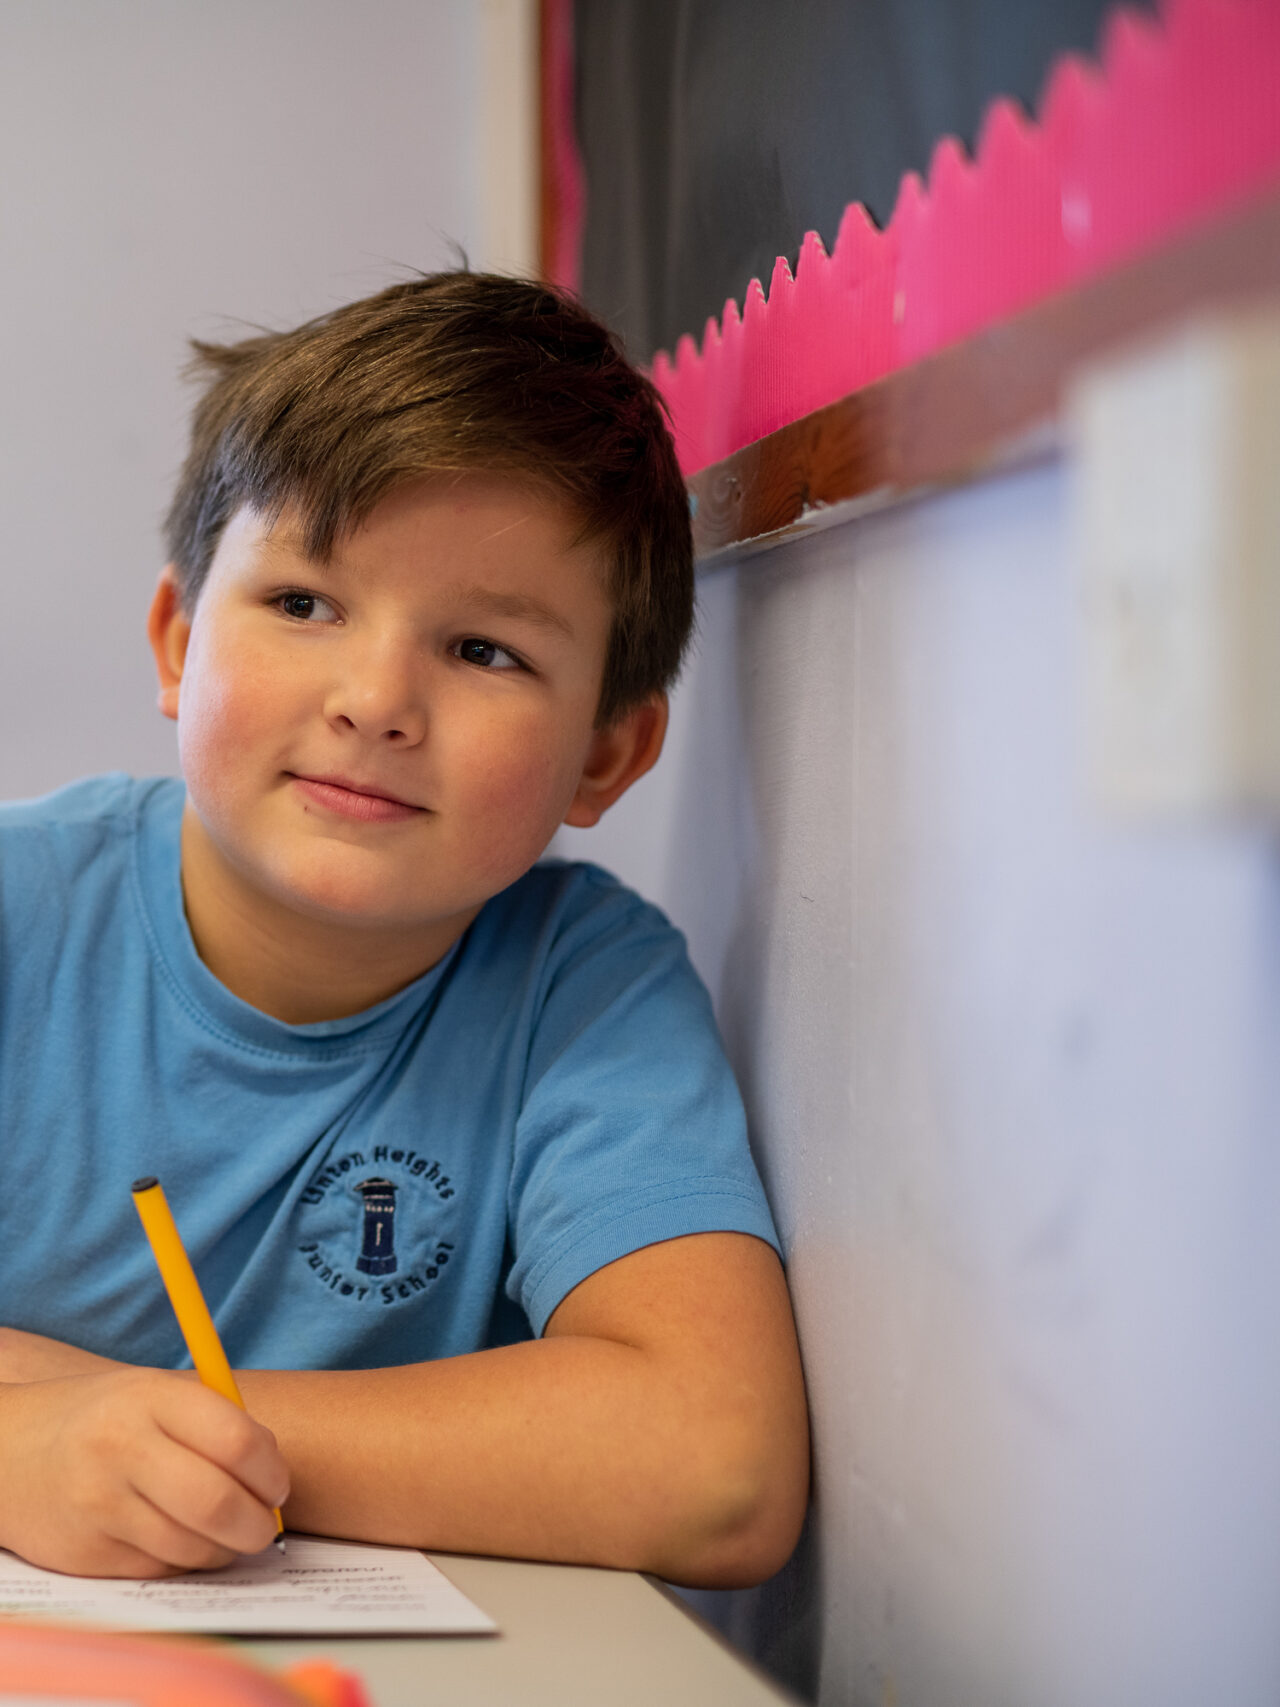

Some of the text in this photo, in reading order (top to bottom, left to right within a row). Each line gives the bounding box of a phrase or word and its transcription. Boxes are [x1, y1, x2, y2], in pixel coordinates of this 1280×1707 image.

[374, 1145, 456, 1201] Heights
[298, 1241, 455, 1305] Junior School
